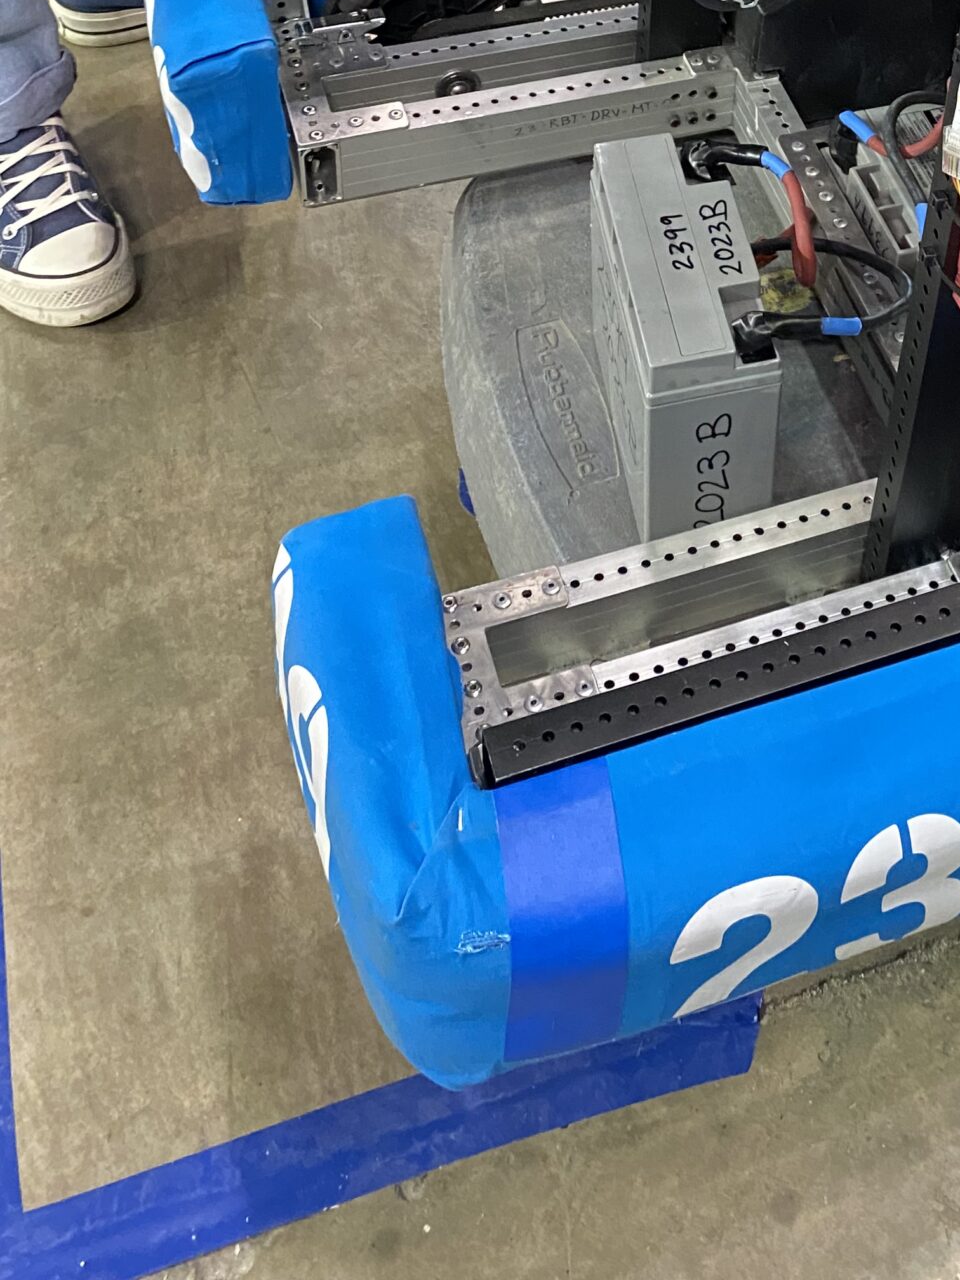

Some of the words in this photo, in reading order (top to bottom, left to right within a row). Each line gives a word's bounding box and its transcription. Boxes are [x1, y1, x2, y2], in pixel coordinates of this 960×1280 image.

[660, 214, 694, 270] 2399
[699, 199, 743, 275] 2023B
[532, 326, 597, 481] Rubbermaid
